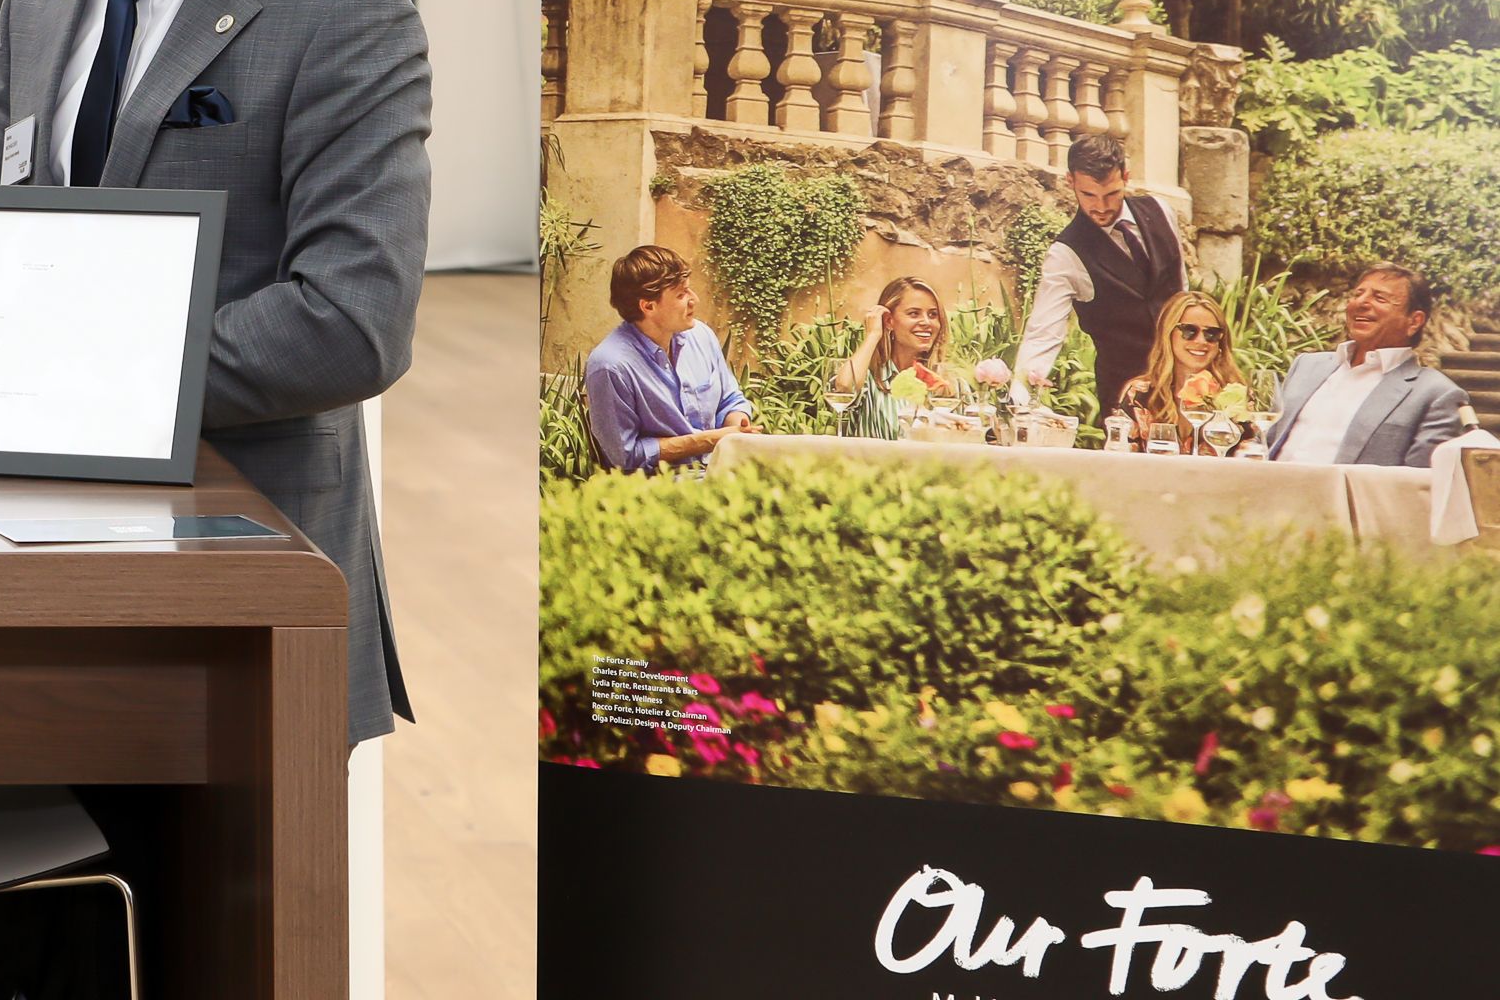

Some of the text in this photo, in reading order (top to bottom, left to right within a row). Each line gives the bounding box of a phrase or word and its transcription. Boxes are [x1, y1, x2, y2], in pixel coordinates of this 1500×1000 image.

[592, 655, 649, 669] The Forte Family
[592, 666, 689, 683] Charles Forte, Development
[592, 679, 610, 688] Lydia
[611, 681, 632, 690] Forte,
[632, 683, 675, 694] Restaurants
[682, 688, 699, 696] Bars
[591, 690, 663, 705] Irene Forte, Wellness
[591, 702, 613, 711] Rocco
[614, 704, 634, 714] Forte,
[635, 707, 664, 717] Hotelier
[672, 710, 707, 720] Chairman
[591, 714, 609, 724] Olga
[609, 716, 633, 726] Polizzi,
[634, 718, 659, 729] Design
[667, 722, 695, 732] Deputy
[695, 724, 732, 735] Chairman
[874, 864, 1363, 1000] Our Forte
